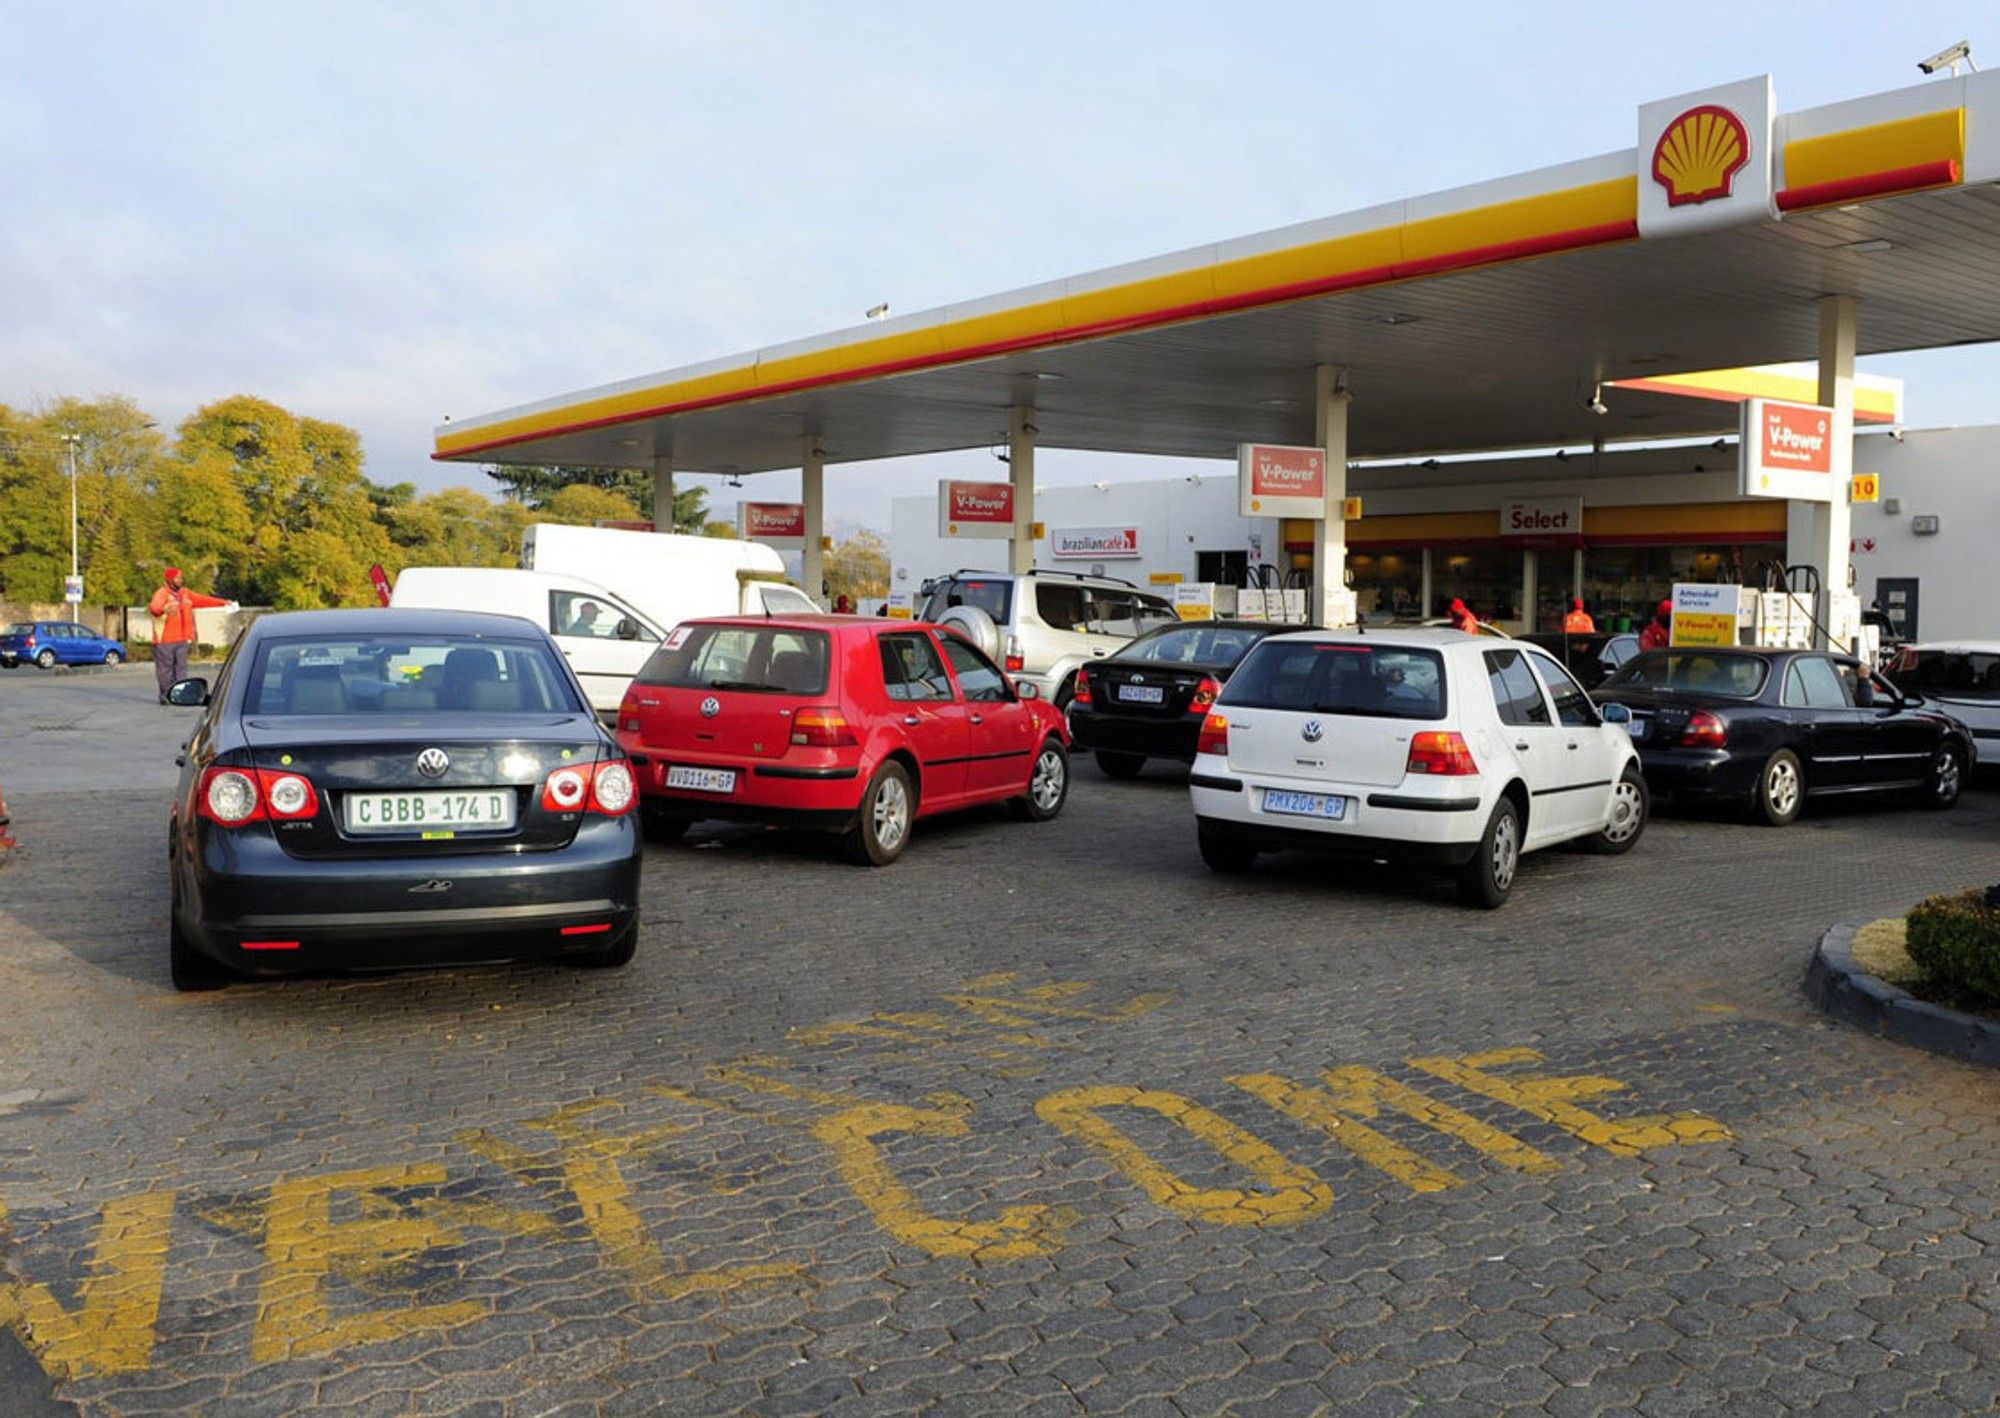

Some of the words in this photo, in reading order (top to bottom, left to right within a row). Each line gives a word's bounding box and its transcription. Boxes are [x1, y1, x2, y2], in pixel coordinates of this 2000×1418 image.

[1769, 424, 1823, 452] V-Power
[1260, 463, 1314, 482] V-Power
[1854, 481, 1875, 496] 10
[956, 495, 1006, 511] V-Power
[1511, 509, 1569, 529] Select
[1679, 599, 1710, 607] Service
[717, 773, 732, 788] GP
[359, 798, 371, 823] C
[381, 797, 426, 823] BBB
[442, 796, 480, 821] 174
[491, 795, 502, 820] D
[1325, 796, 1343, 815] GP
